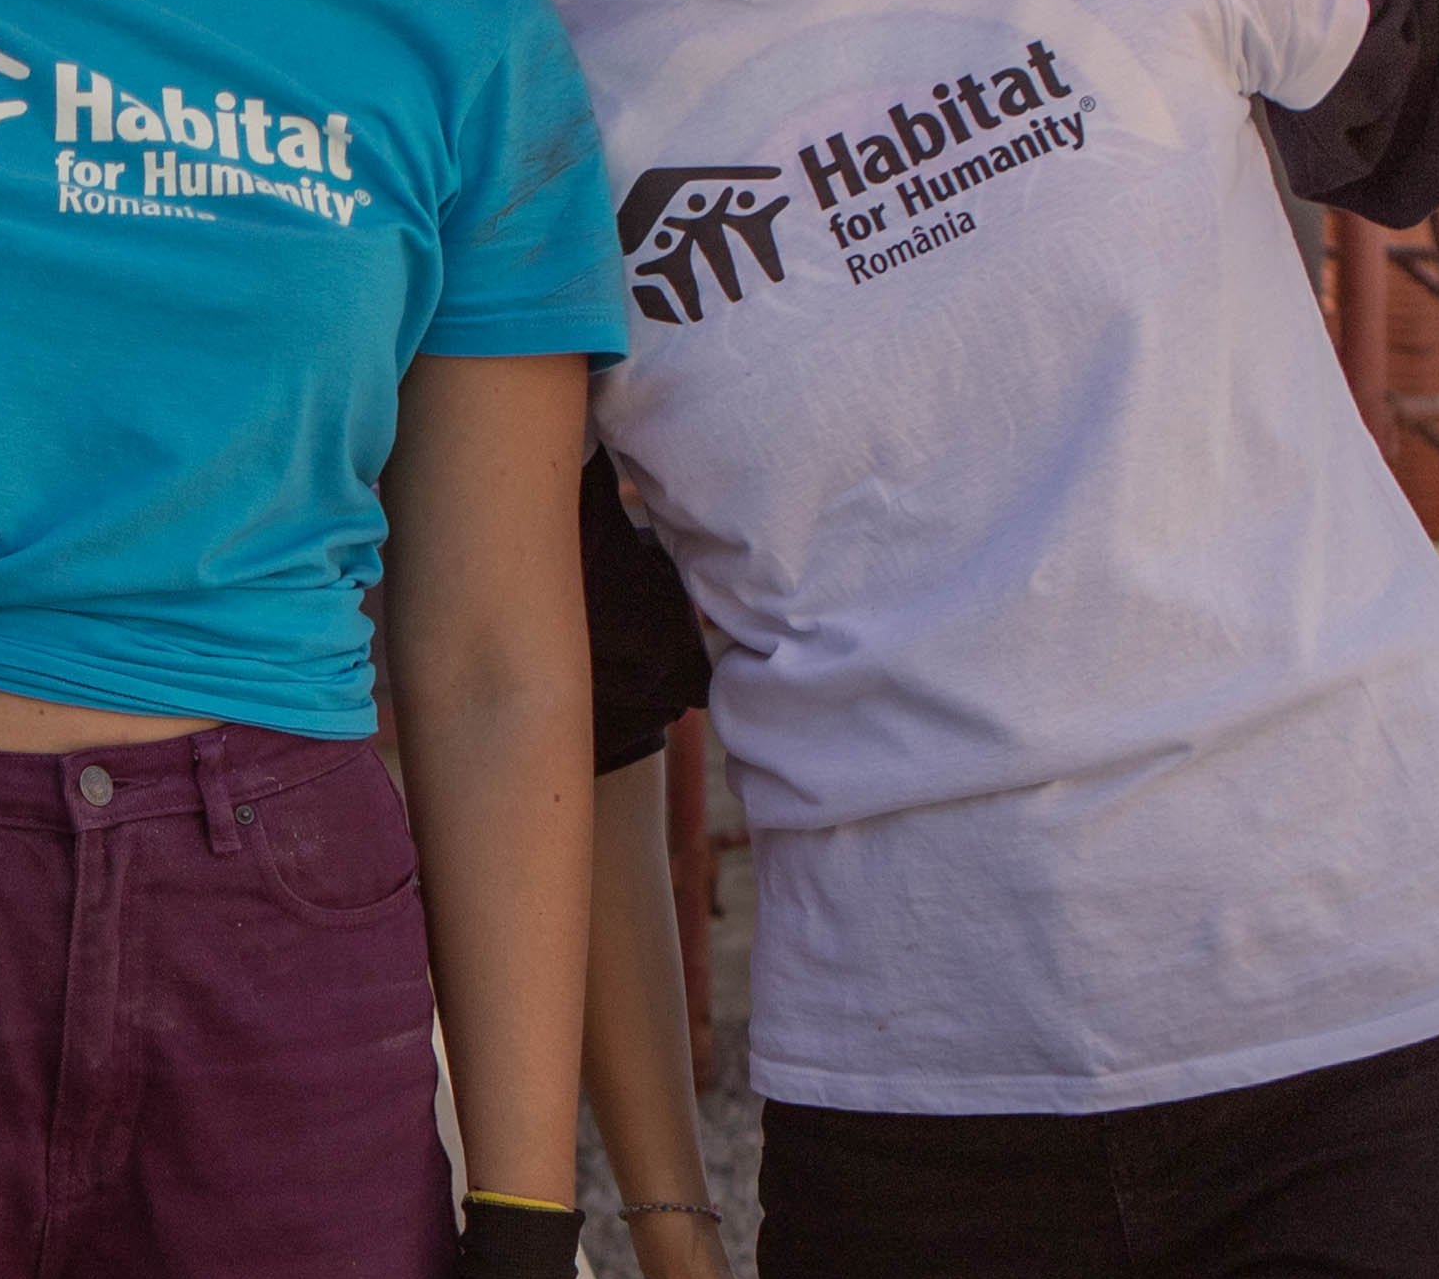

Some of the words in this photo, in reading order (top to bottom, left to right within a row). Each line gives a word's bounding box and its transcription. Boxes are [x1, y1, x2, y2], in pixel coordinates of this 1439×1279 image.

[54, 62, 354, 181] Habitat
[799, 39, 1073, 211] Habitat
[55, 149, 126, 190] for
[829, 202, 886, 251] for
[844, 210, 977, 286] România
